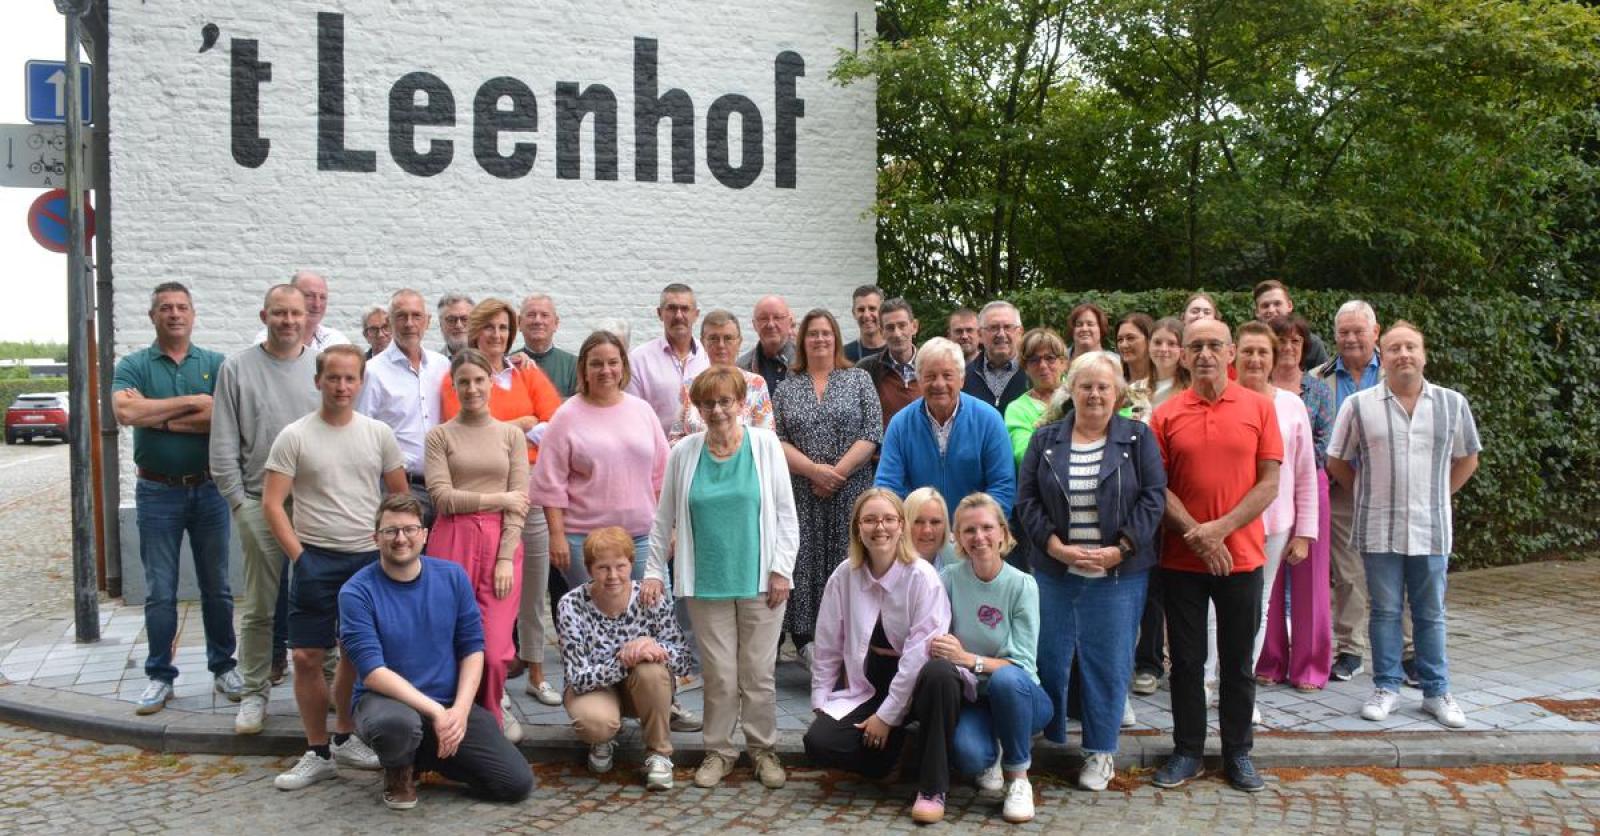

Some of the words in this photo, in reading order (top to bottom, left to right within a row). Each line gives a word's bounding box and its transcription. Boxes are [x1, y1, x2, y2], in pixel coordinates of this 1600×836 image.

[199, 23, 272, 169] 't
[317, 12, 805, 189] Leenhof
[43, 176, 53, 186] A
